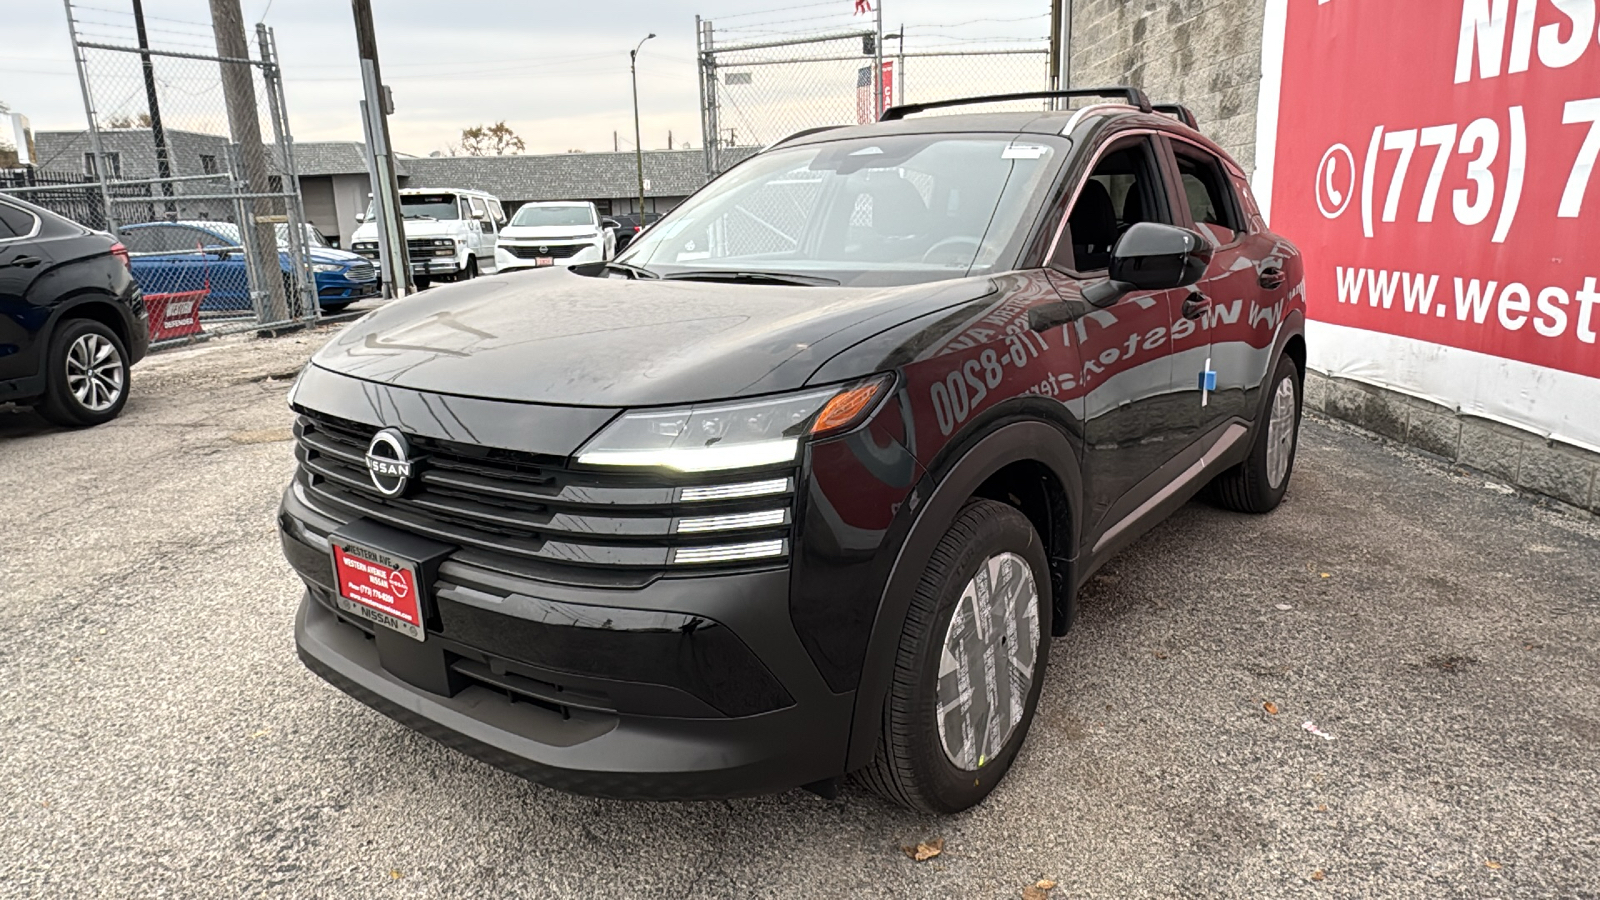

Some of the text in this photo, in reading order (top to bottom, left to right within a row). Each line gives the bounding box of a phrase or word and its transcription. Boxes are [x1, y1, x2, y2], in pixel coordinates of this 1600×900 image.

[1453, 0, 1600, 84] NIS
[1361, 105, 1527, 243] (773)
[1336, 266, 1600, 343] www.west
[361, 606, 398, 628] NISSAN
[370, 575, 388, 588] NISSAN
